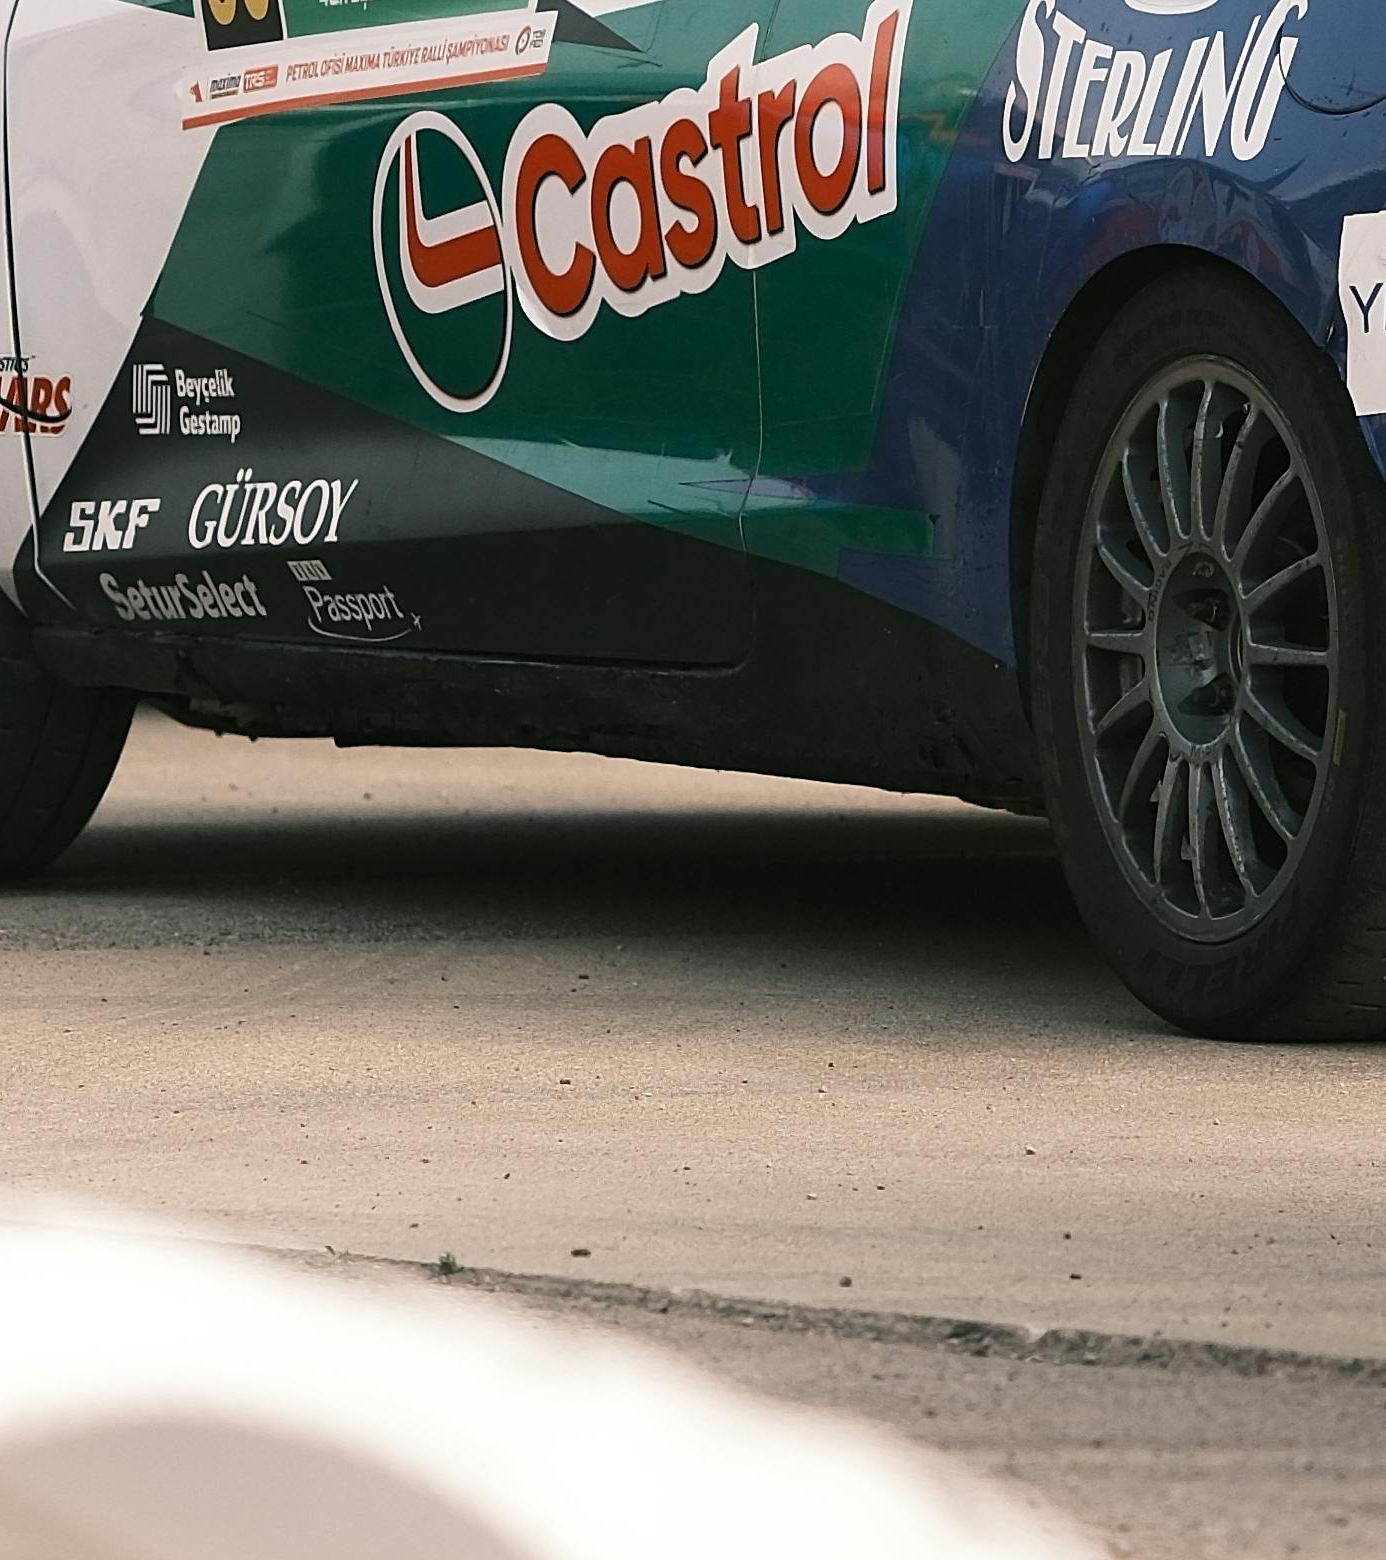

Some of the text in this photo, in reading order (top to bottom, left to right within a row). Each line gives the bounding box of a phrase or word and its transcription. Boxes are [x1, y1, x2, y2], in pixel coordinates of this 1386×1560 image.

[514, 7, 900, 317] Castrol
[174, 368, 235, 406] Beyçelik
[179, 405, 241, 443] Gestamp
[63, 498, 161, 553] SKF
[187, 468, 360, 549] GÜRSOY
[99, 570, 268, 622] SeturSelect
[303, 584, 405, 631] Passport
